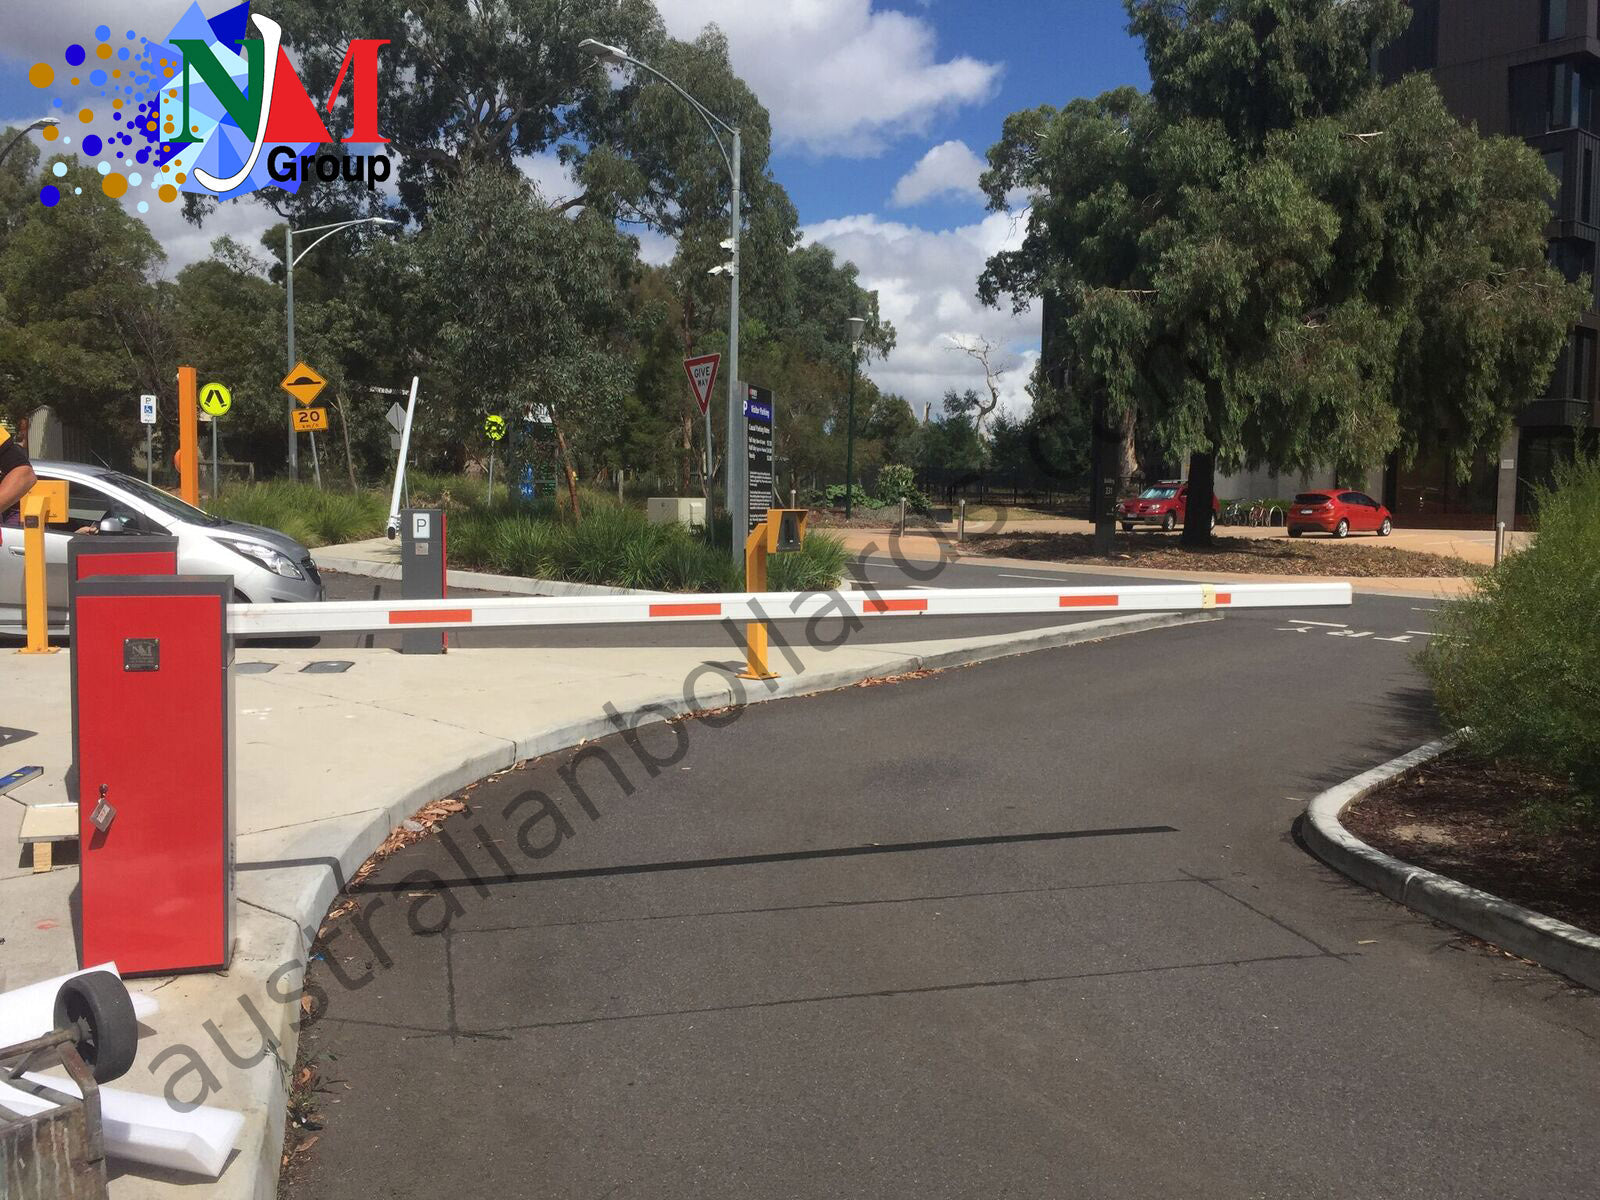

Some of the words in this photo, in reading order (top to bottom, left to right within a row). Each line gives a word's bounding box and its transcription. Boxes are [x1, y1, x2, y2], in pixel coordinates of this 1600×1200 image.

[694, 366, 710, 378] GIVE
[743, 400, 748, 415] P
[299, 411, 320, 423] 20
[416, 518, 427, 533] P
